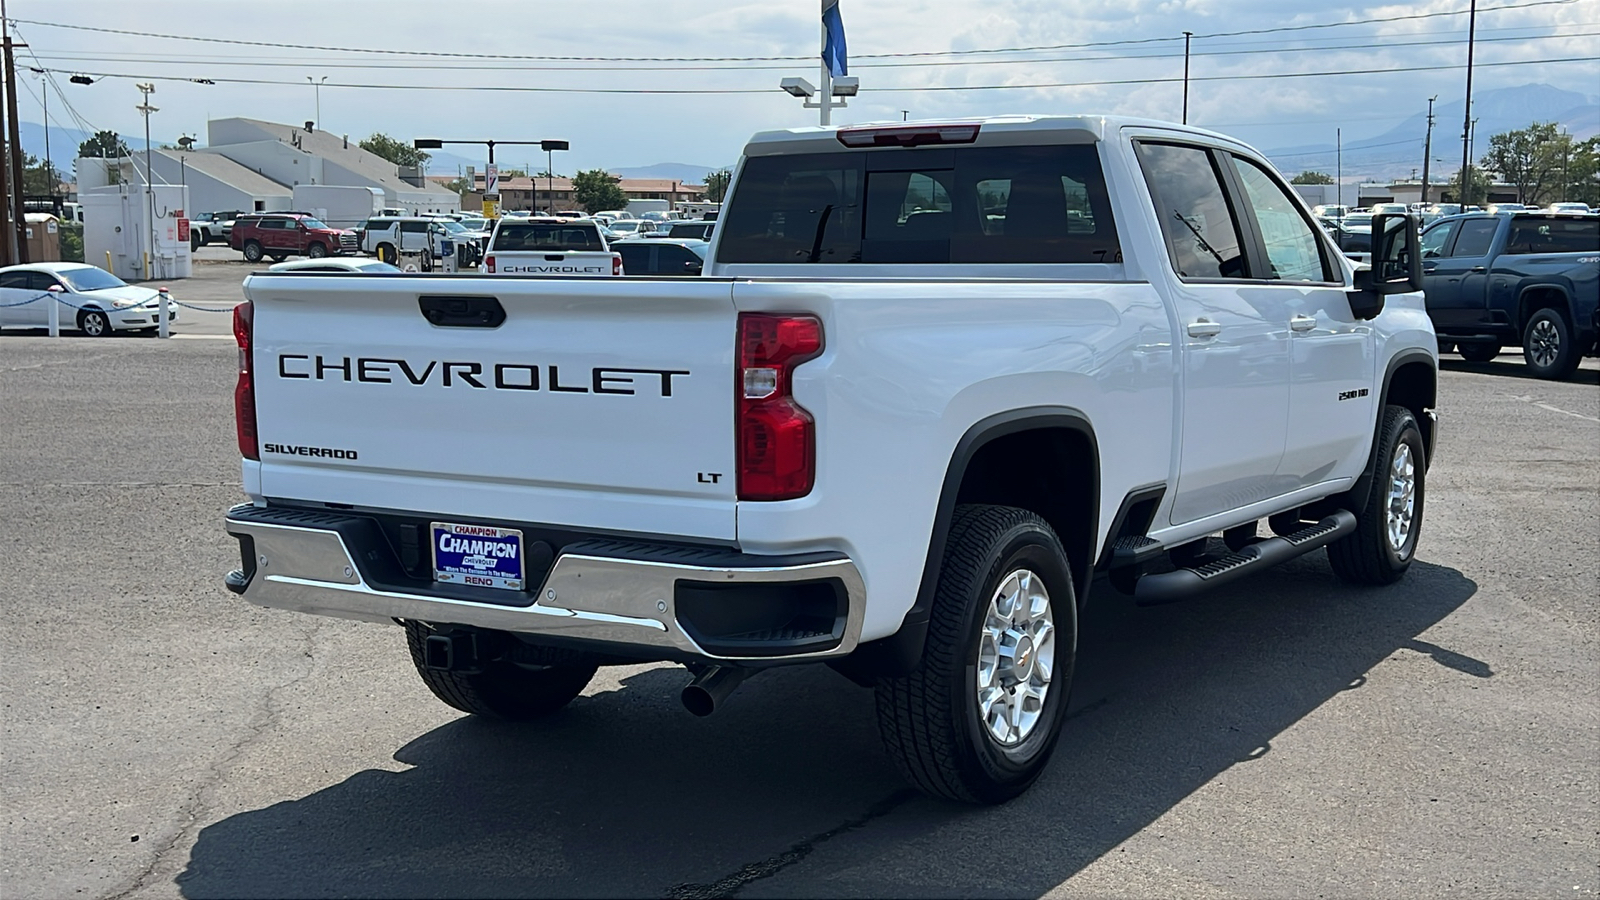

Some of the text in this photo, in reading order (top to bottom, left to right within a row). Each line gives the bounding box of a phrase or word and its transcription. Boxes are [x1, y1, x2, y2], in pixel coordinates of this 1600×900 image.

[279, 354, 690, 398] CHEVROLET
[264, 443, 358, 460] SILVERADO
[697, 472, 722, 484] LT
[454, 525, 498, 537] CHAMPION
[439, 533, 517, 559] CHAMPION
[464, 557, 496, 566] CHEVROLET
[464, 576, 493, 586] RENO
